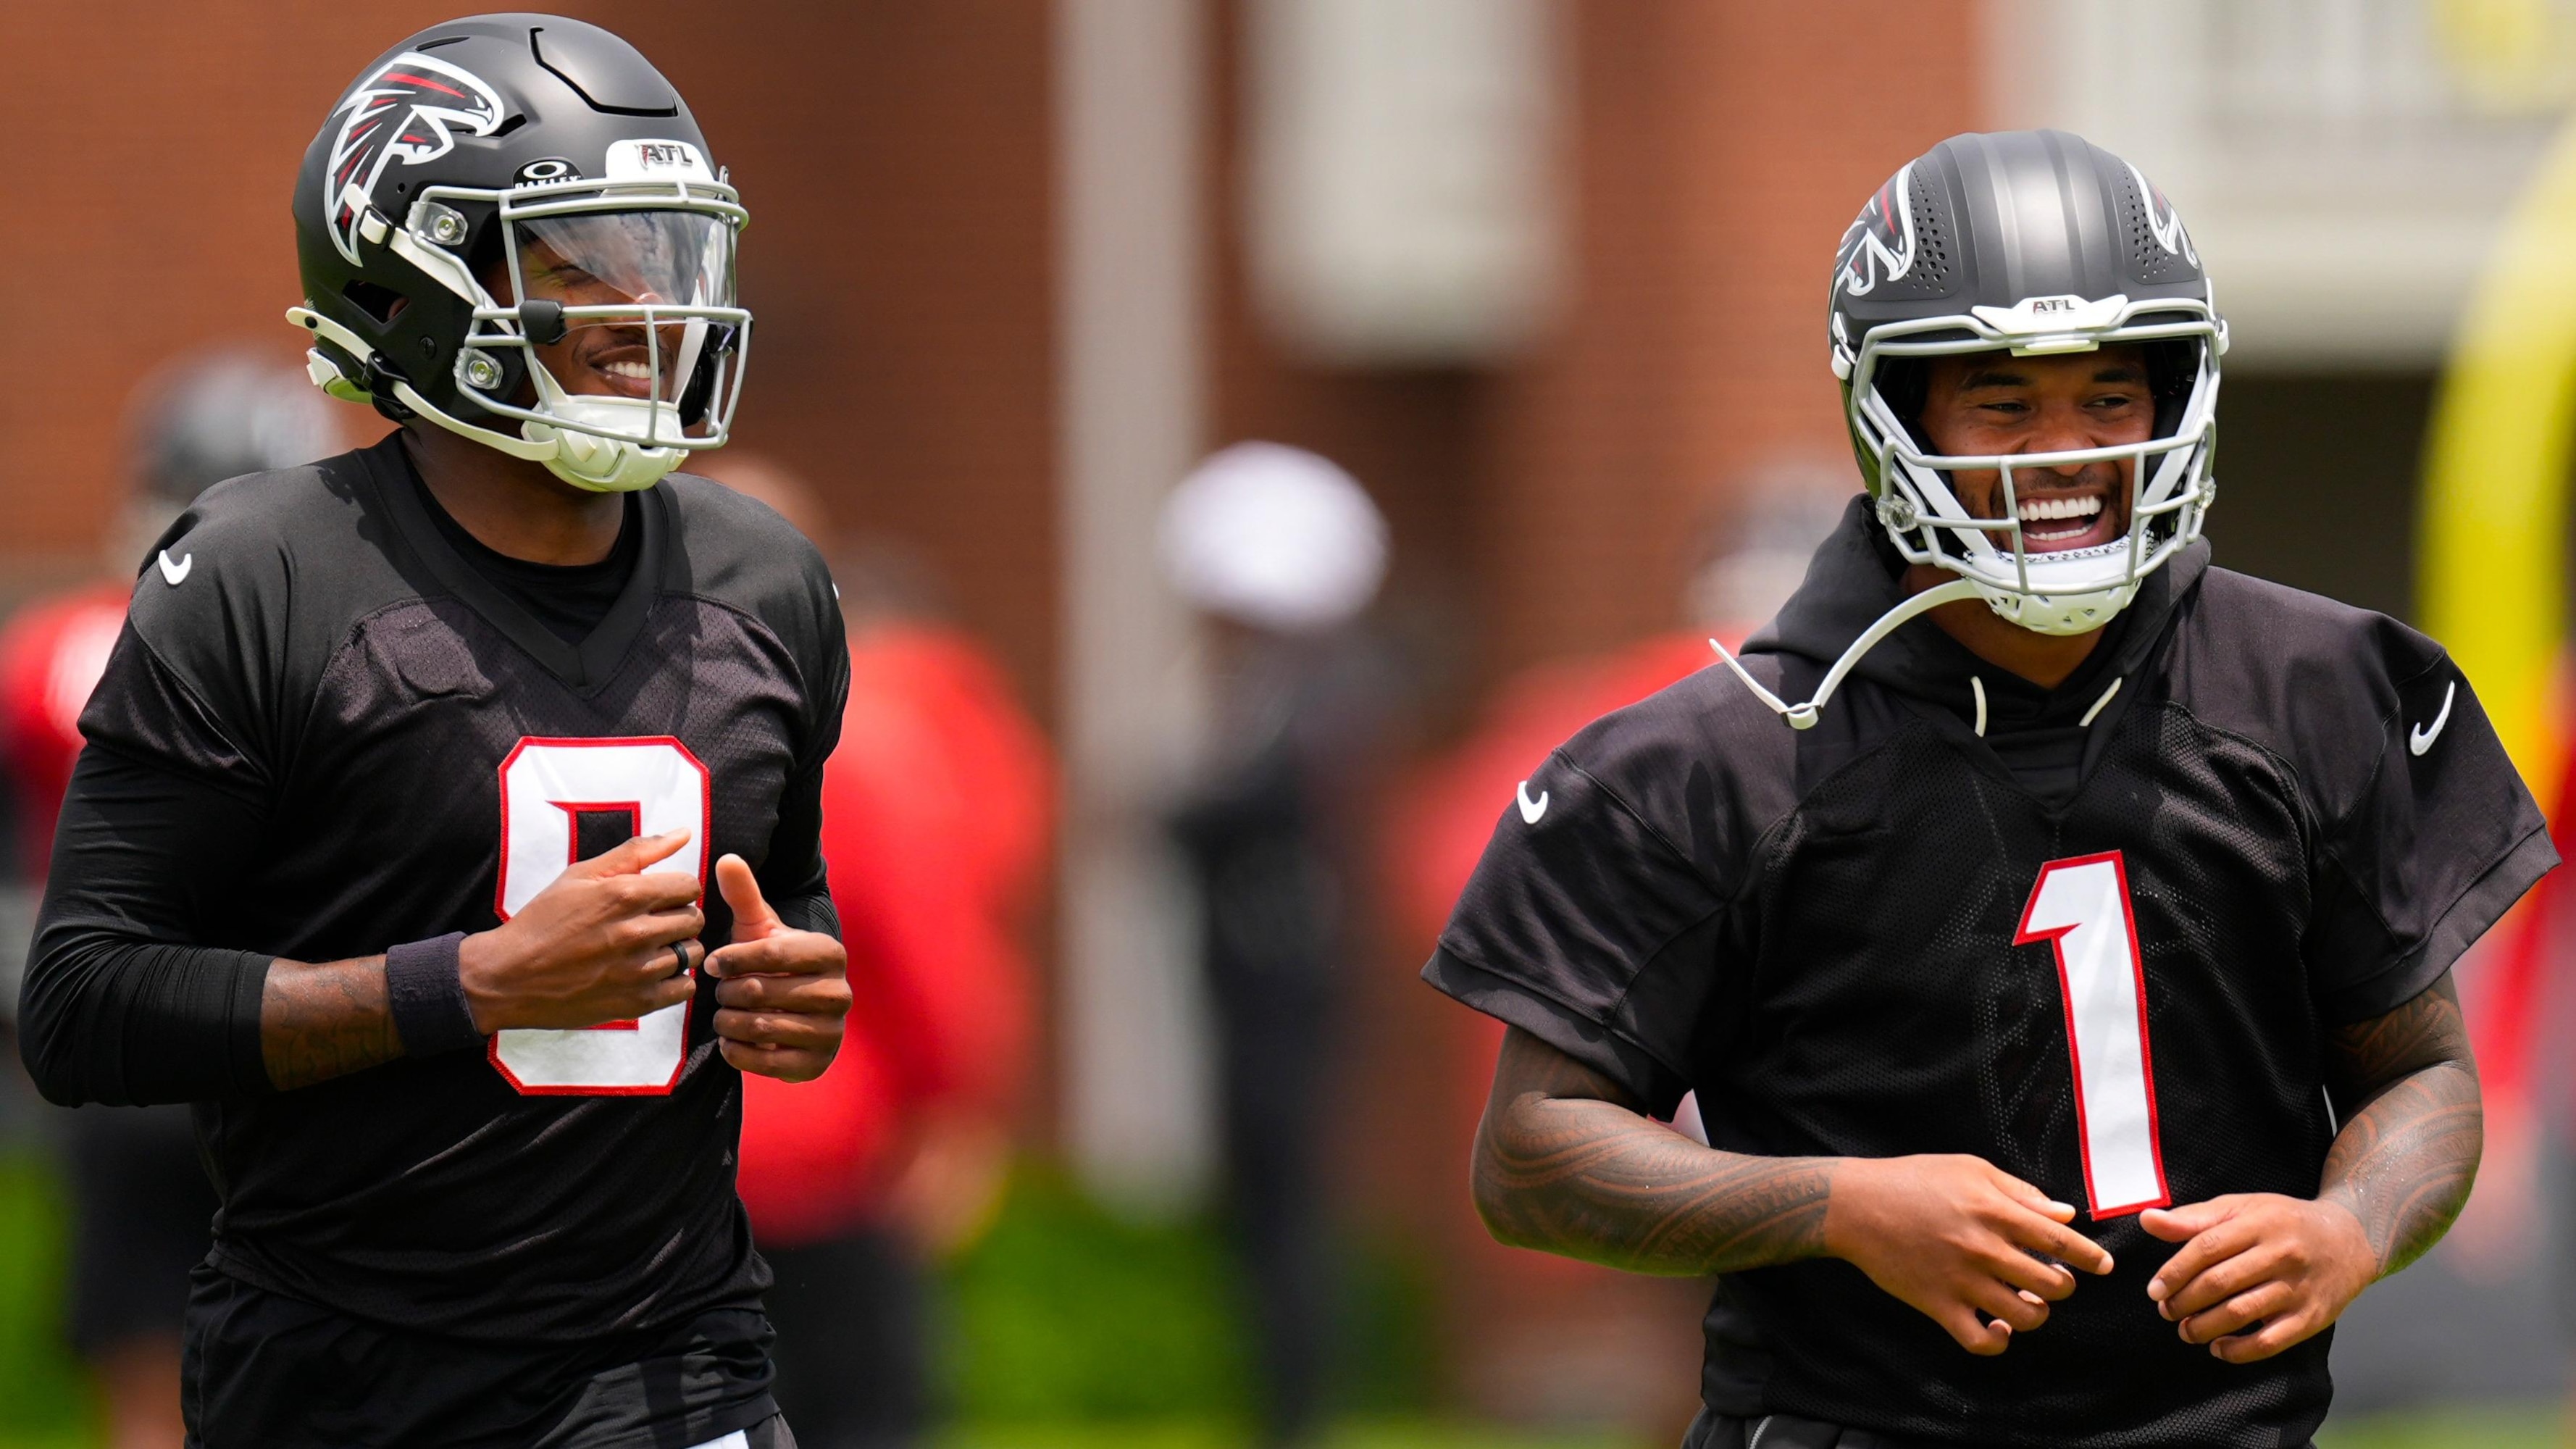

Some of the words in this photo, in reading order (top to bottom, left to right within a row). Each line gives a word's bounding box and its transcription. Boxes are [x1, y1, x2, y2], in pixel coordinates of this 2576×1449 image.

[639, 143, 693, 167] ATL
[2033, 299, 2075, 314] ATL
[2012, 848, 2172, 1222] 1
